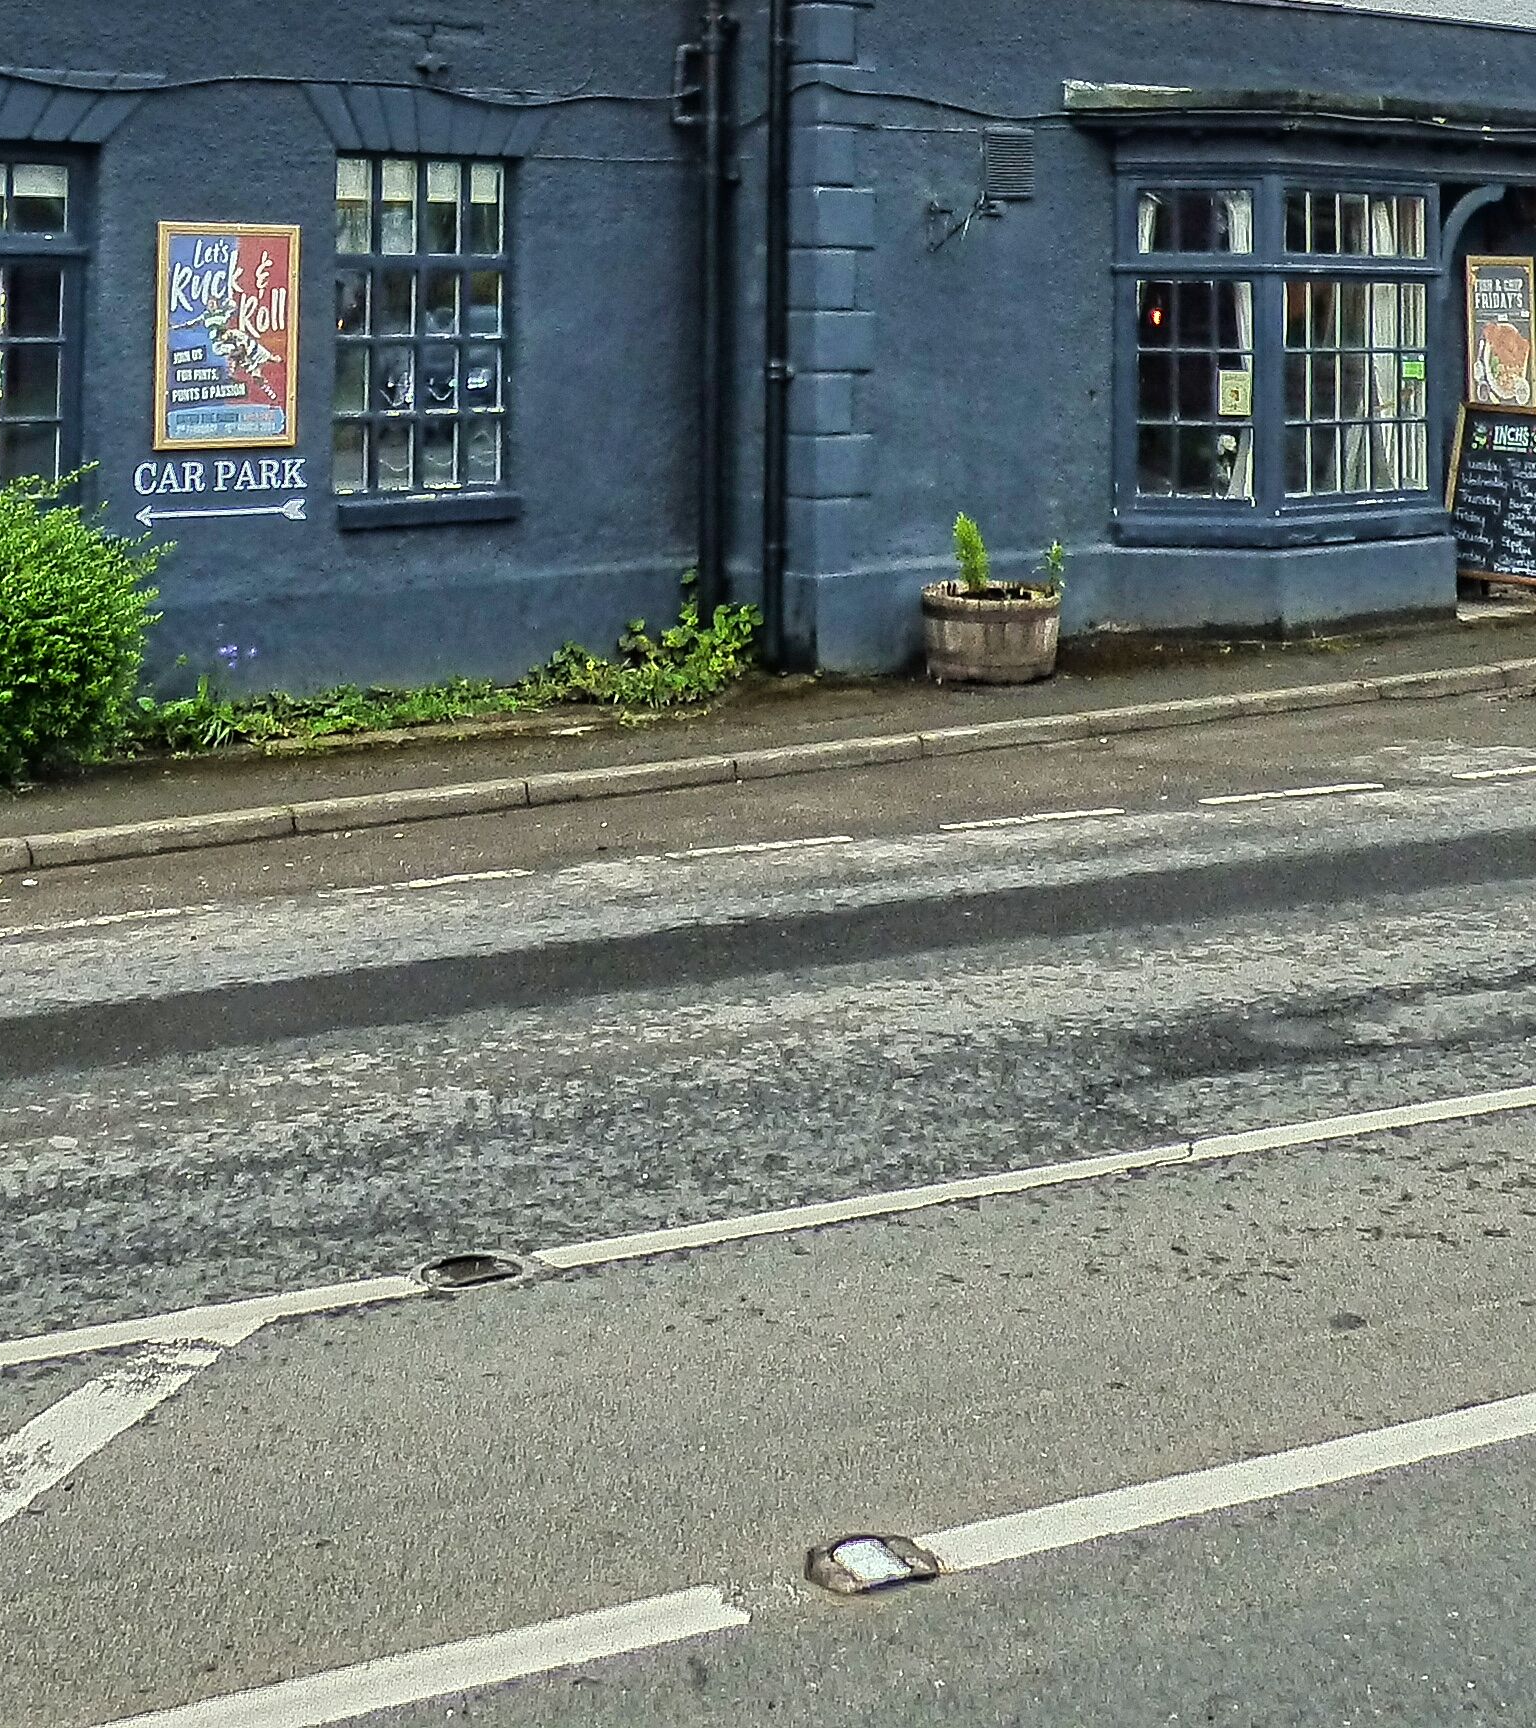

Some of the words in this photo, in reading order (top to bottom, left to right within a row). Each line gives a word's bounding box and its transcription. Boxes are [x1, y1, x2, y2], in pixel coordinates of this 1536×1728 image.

[193, 239, 229, 269] Let's
[170, 250, 244, 312] Ruck
[239, 287, 287, 339] Roll
[133, 460, 206, 495] CAR
[212, 457, 308, 491] PARK
